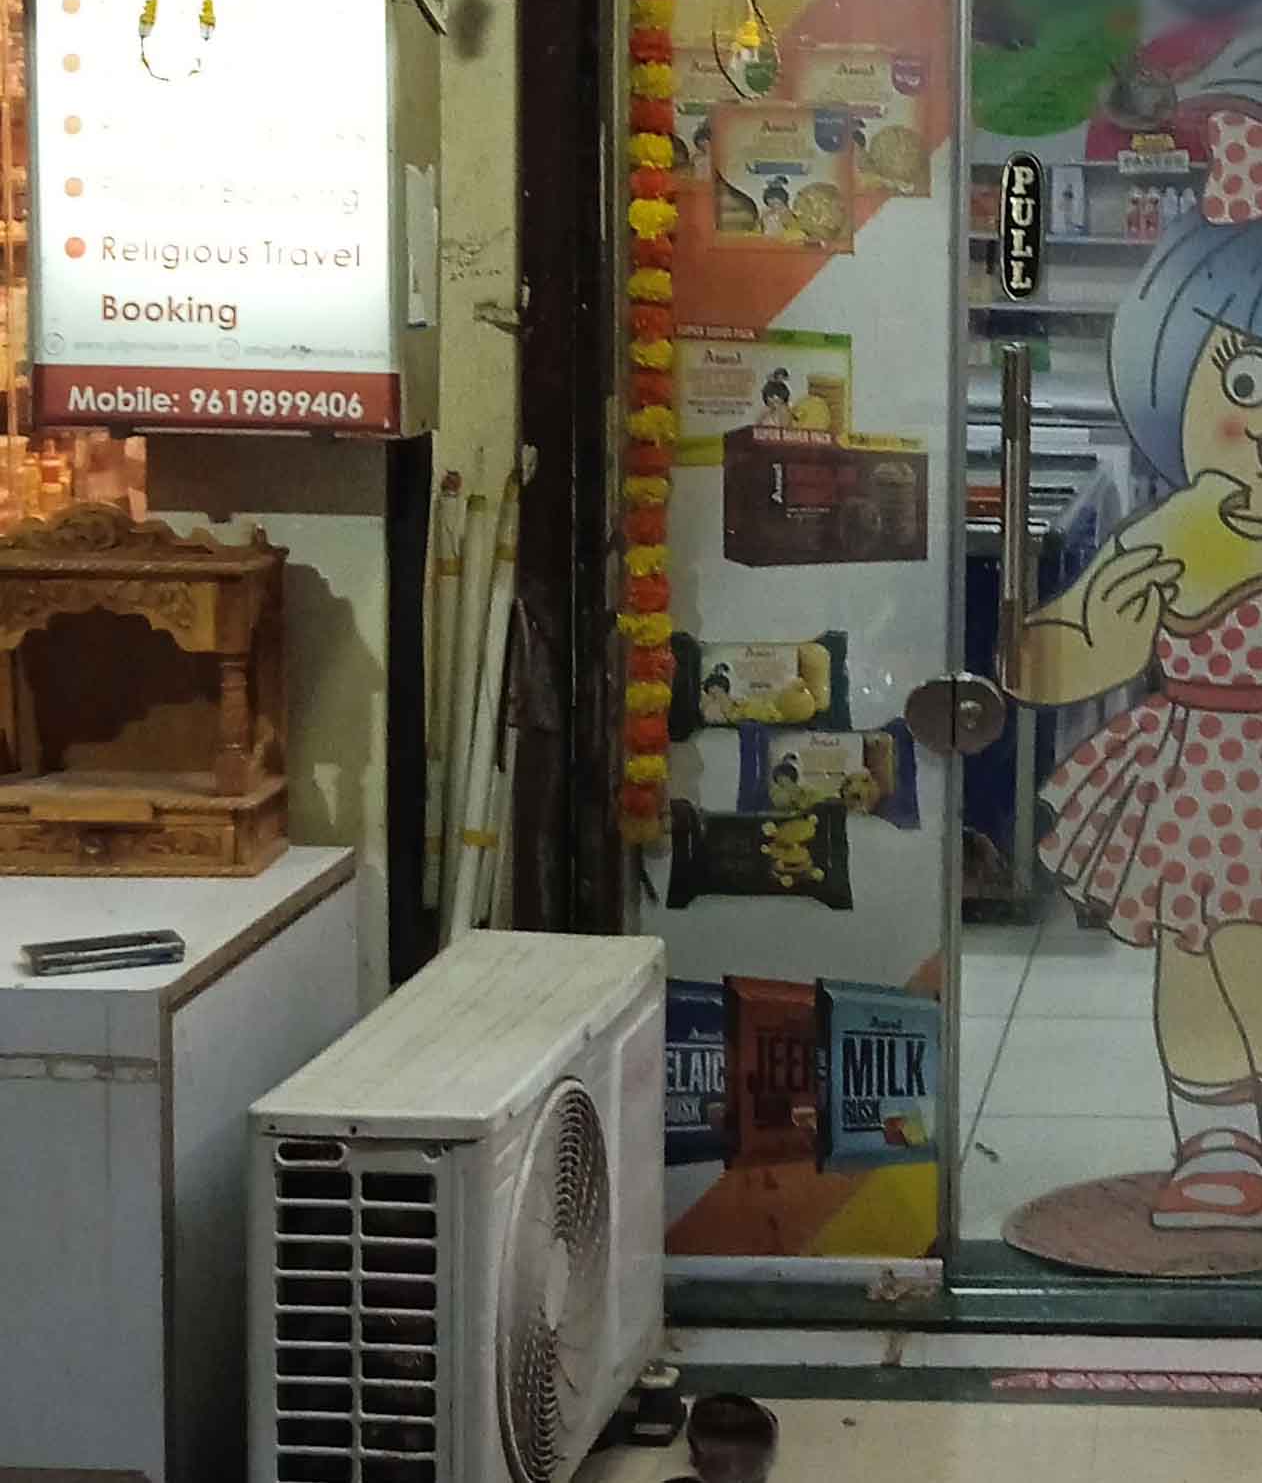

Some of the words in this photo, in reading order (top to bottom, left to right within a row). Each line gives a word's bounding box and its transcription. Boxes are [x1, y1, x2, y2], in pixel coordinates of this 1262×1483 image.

[1009, 165, 1036, 291] PULL
[101, 236, 249, 270] Religious
[264, 240, 361, 268] Travel
[101, 295, 238, 330] Booking
[67, 385, 180, 413] Mobile:
[190, 388, 363, 418] 9619899406
[842, 1037, 927, 1097] MILK
